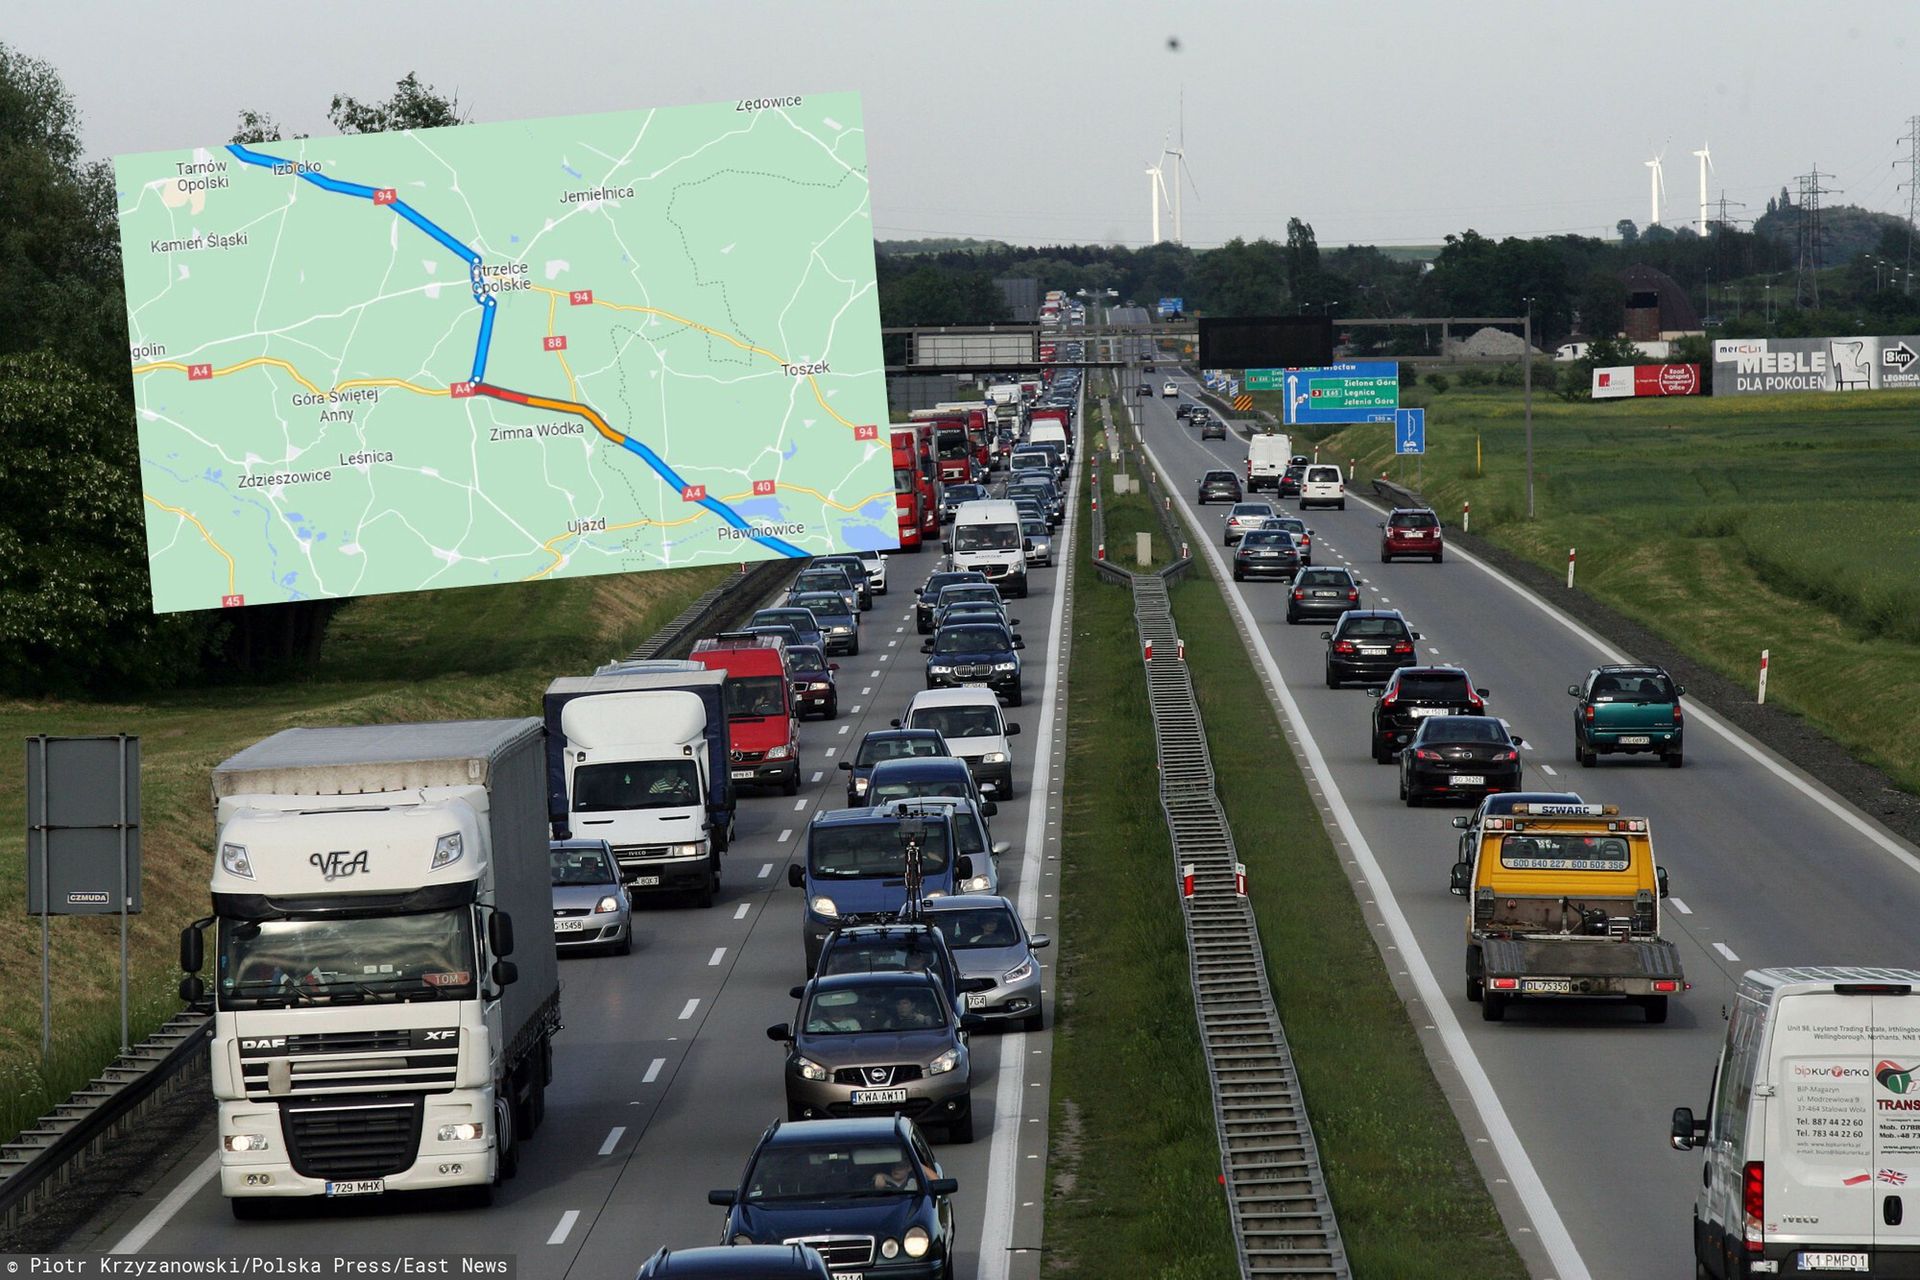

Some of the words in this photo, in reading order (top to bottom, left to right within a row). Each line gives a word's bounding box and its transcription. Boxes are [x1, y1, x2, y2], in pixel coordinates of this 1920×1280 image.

[1886, 351, 1910, 362] 8km
[1738, 352, 1826, 374] MEBLE
[1738, 378, 1762, 390] DLA
[1766, 373, 1826, 390] POKOLEŃ
[1883, 374, 1920, 382] LEGNICA
[1344, 379, 1374, 387] Zielona
[1344, 389, 1375, 398] Legnica
[1344, 398, 1372, 406] Jelenia
[1542, 806, 1590, 814] SZWARC
[310, 850, 370, 881] VFA
[1590, 861, 1605, 869] 602
[1608, 861, 1624, 869] 356
[70, 894, 107, 902] CZMUDA
[561, 922, 582, 930] 15458
[435, 973, 459, 985] TOM
[1542, 982, 1568, 990] 75356
[1813, 1025, 1838, 1033] Leyland
[242, 1039, 287, 1049] DAF
[423, 1031, 456, 1041] XF
[857, 1093, 878, 1102] KWA
[881, 1091, 905, 1101] AW11
[335, 1183, 353, 1192] 729
[357, 1181, 380, 1191] MHX
[1783, 1214, 1819, 1224] IVECO
[1805, 1255, 1820, 1266] K1
